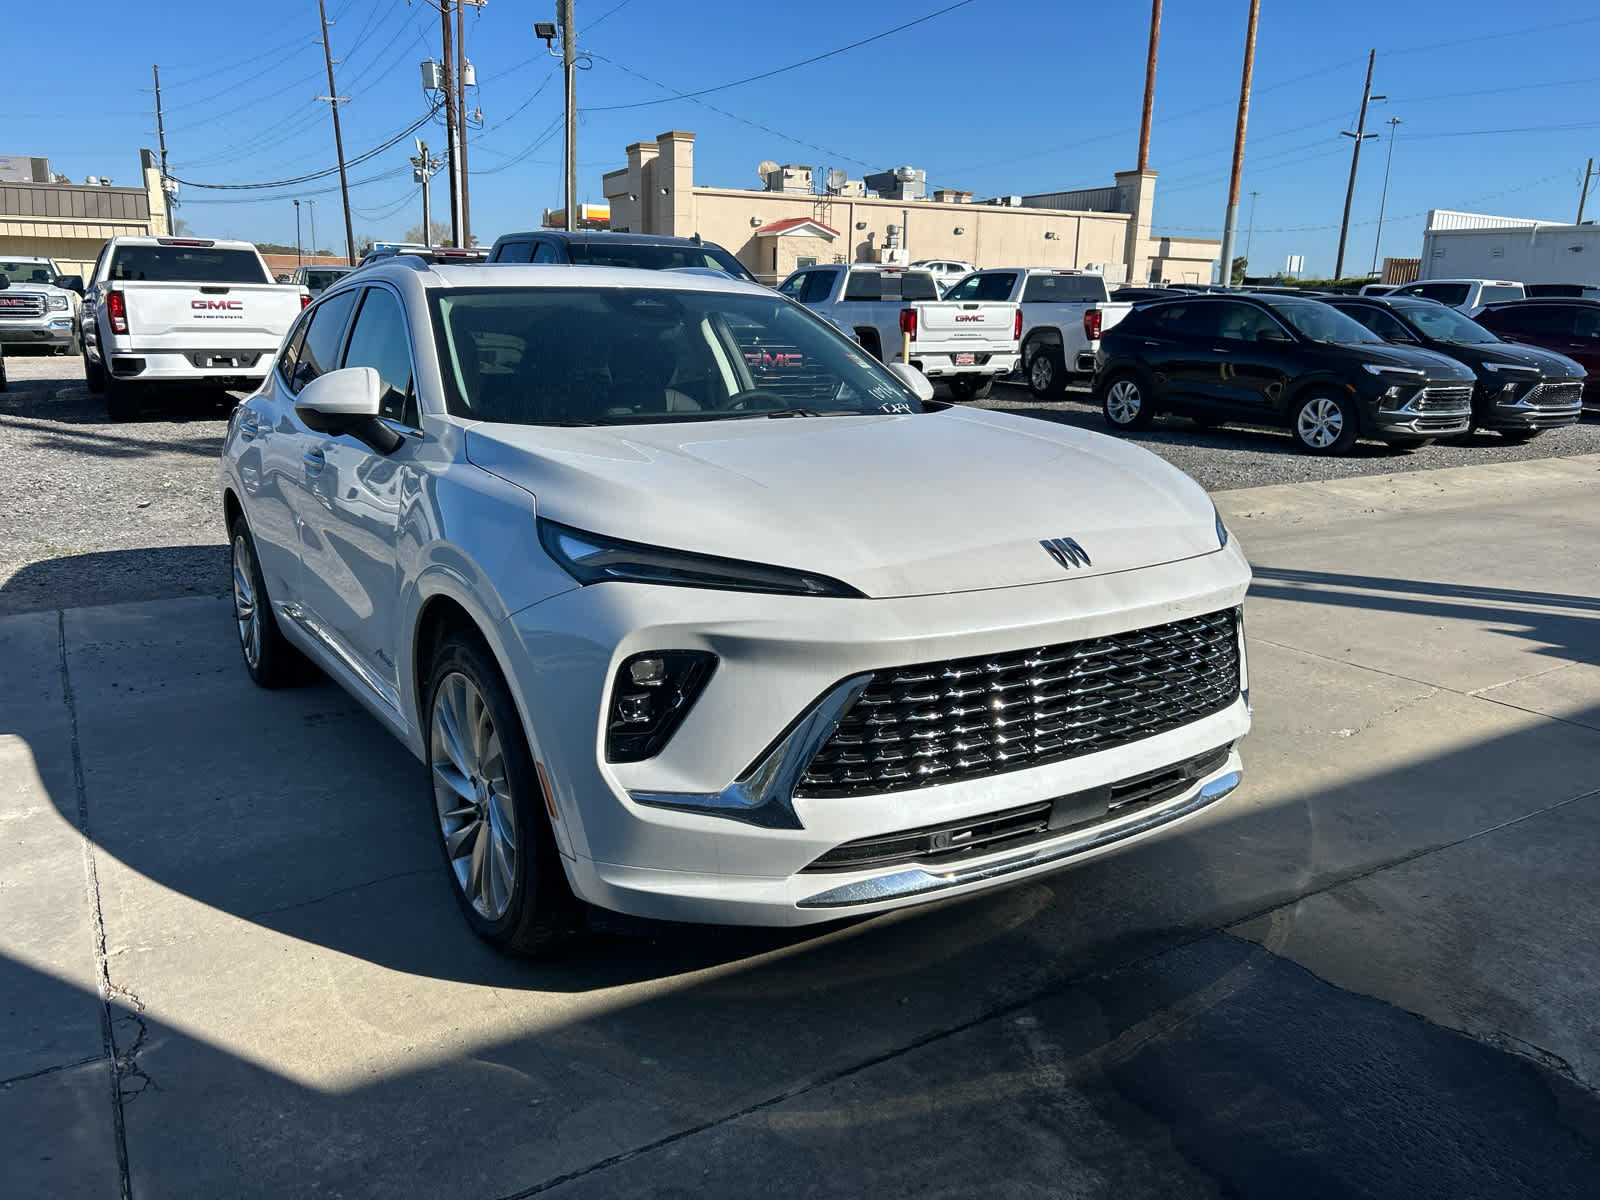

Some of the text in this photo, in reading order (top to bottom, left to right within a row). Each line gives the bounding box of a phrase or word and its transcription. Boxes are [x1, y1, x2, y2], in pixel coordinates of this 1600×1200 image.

[191, 300, 243, 310] GMC
[955, 314, 984, 322] GMC
[744, 353, 803, 367] GMC
